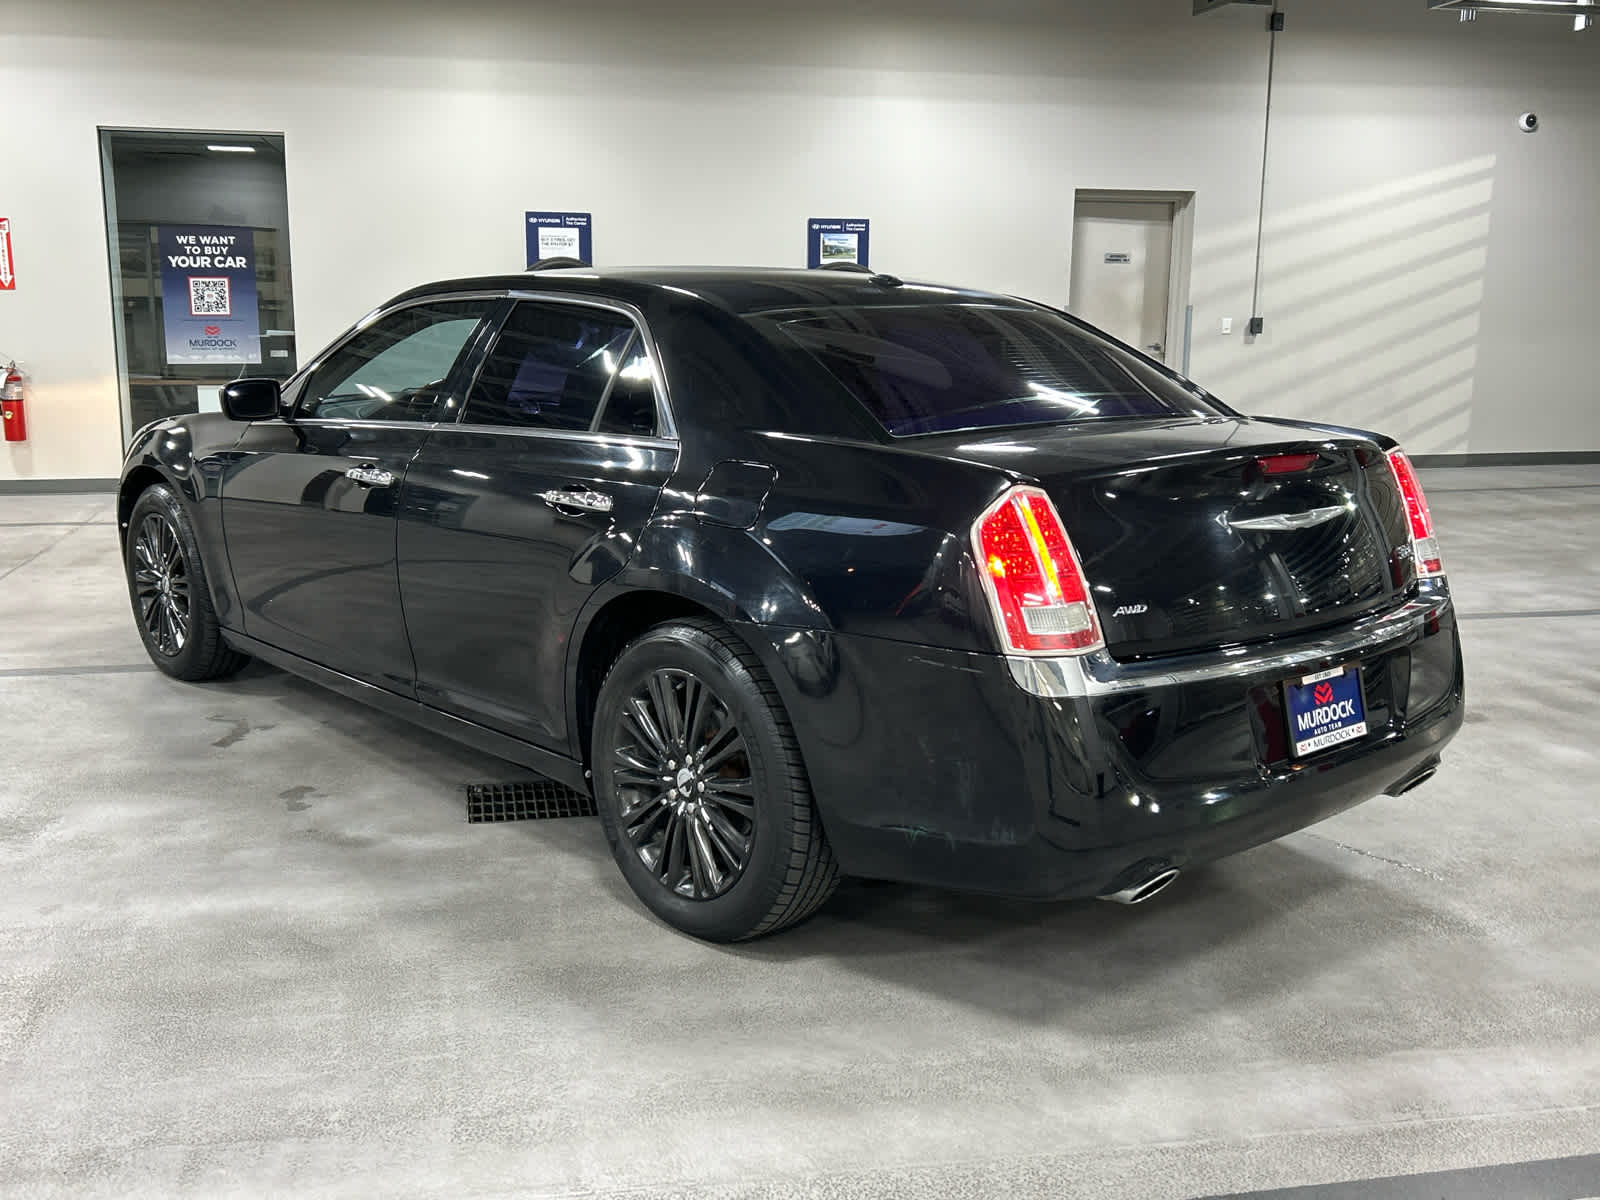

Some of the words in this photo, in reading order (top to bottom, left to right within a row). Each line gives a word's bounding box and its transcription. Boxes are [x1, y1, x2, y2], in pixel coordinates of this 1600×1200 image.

[176, 235, 196, 244] WE
[199, 235, 236, 245] WANT
[184, 246, 201, 255] TO
[204, 246, 229, 255] BUY
[167, 255, 212, 268] YOUR
[214, 256, 247, 269] CAR
[189, 338, 237, 348] MURDOCK
[1112, 604, 1148, 618] AWD
[1297, 698, 1356, 732] MURDOCK
[1313, 726, 1328, 736] AUTO
[1328, 720, 1342, 731] TEAM
[1313, 728, 1352, 748] MURDOCK
